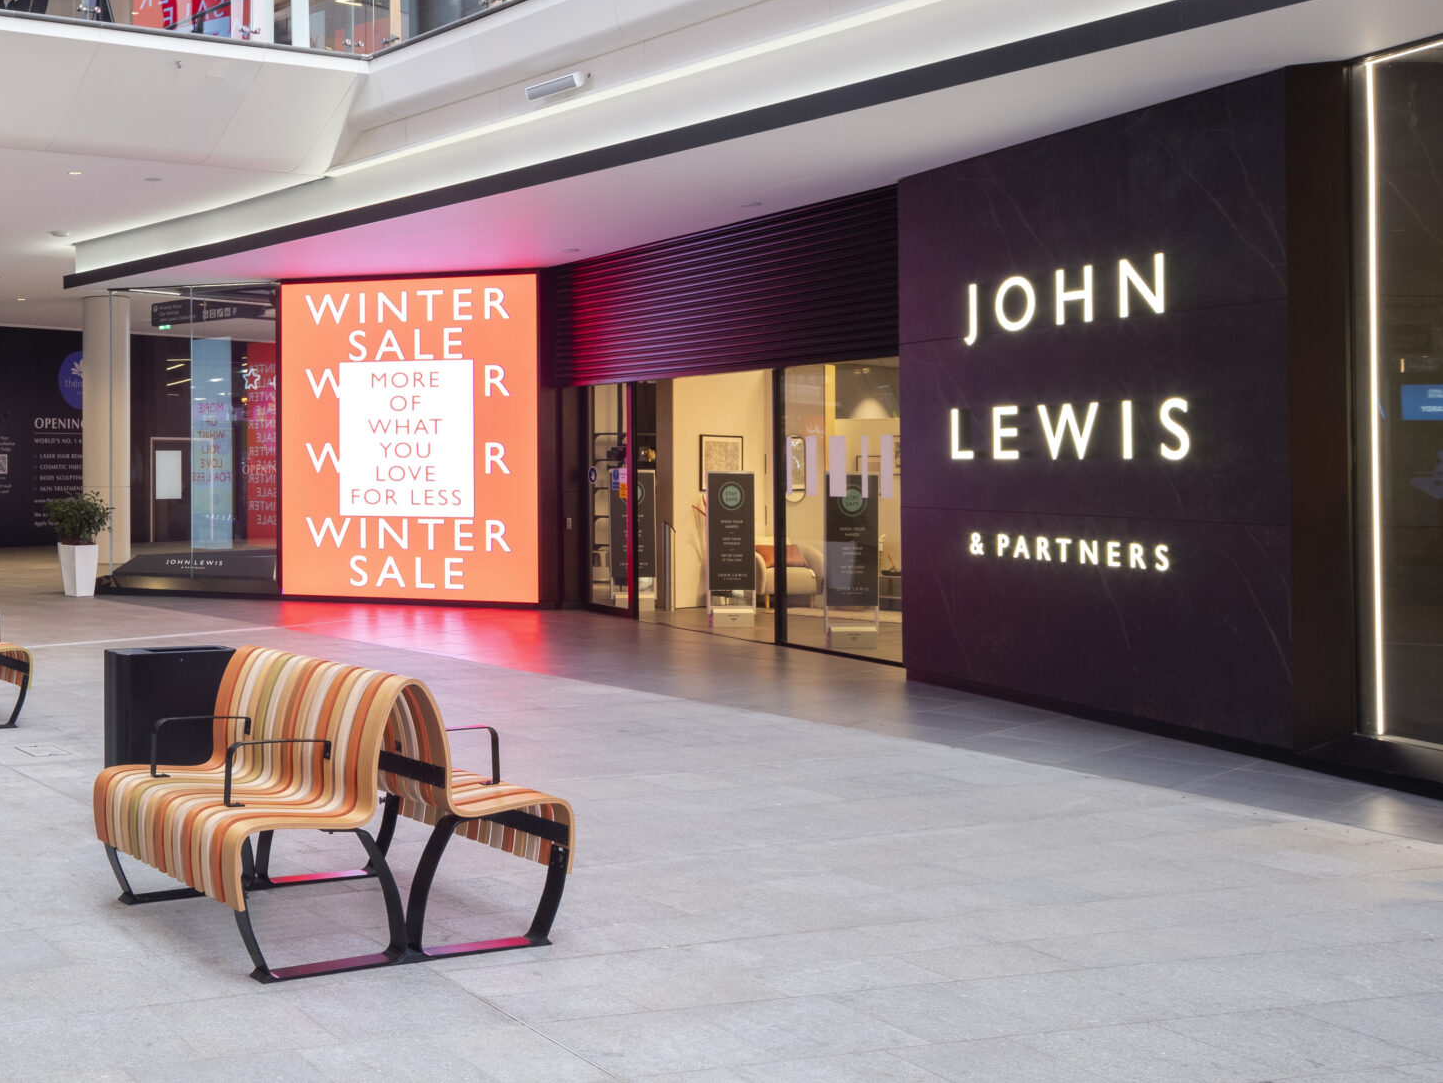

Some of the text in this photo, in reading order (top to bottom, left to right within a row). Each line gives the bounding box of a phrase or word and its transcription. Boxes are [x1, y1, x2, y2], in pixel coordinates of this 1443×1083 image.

[305, 287, 510, 325] WINTER
[964, 252, 1166, 347] JOHN
[349, 327, 464, 362] SALE
[370, 371, 440, 389] MORE
[389, 395, 421, 412] OF
[368, 418, 443, 435] WHAT
[950, 397, 1192, 461] LEWIS
[379, 442, 431, 459] YOU
[376, 465, 436, 483] LOVE
[351, 488, 462, 506] FOR LESS
[306, 517, 511, 552] WINTER
[969, 532, 1170, 572] & PARTNERS
[349, 555, 465, 590] SALE
